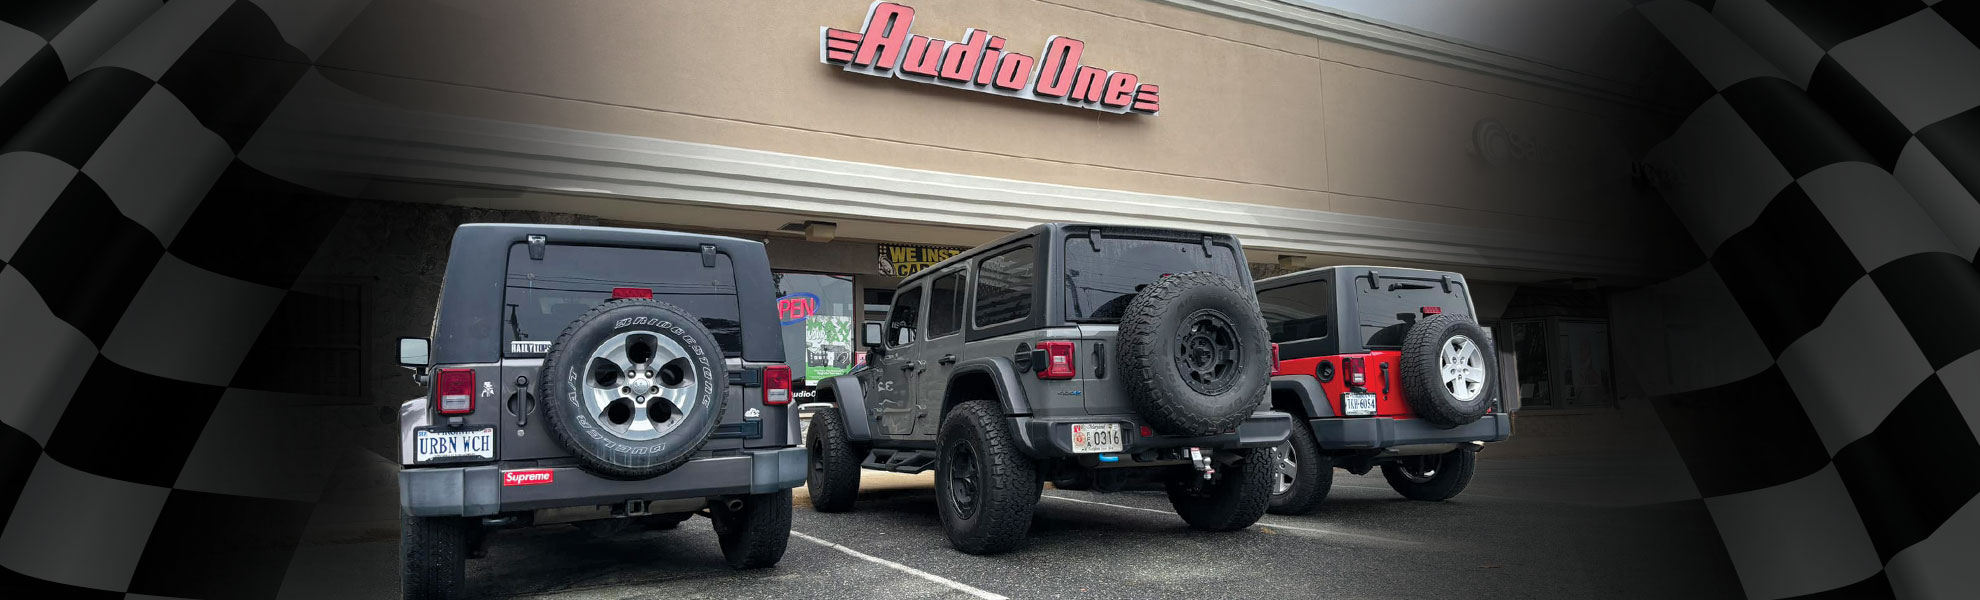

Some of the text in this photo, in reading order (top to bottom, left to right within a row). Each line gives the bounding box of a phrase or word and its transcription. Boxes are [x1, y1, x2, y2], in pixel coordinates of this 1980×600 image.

[852, 2, 1138, 108] Audio One
[890, 246, 917, 262] WE
[777, 298, 815, 320] PEN
[614, 316, 713, 409] BRIDGESTONE
[419, 435, 490, 454] URBN WCH
[576, 414, 666, 455] DUELER
[1094, 431, 1119, 445] 0316
[506, 472, 550, 485] Supreme
